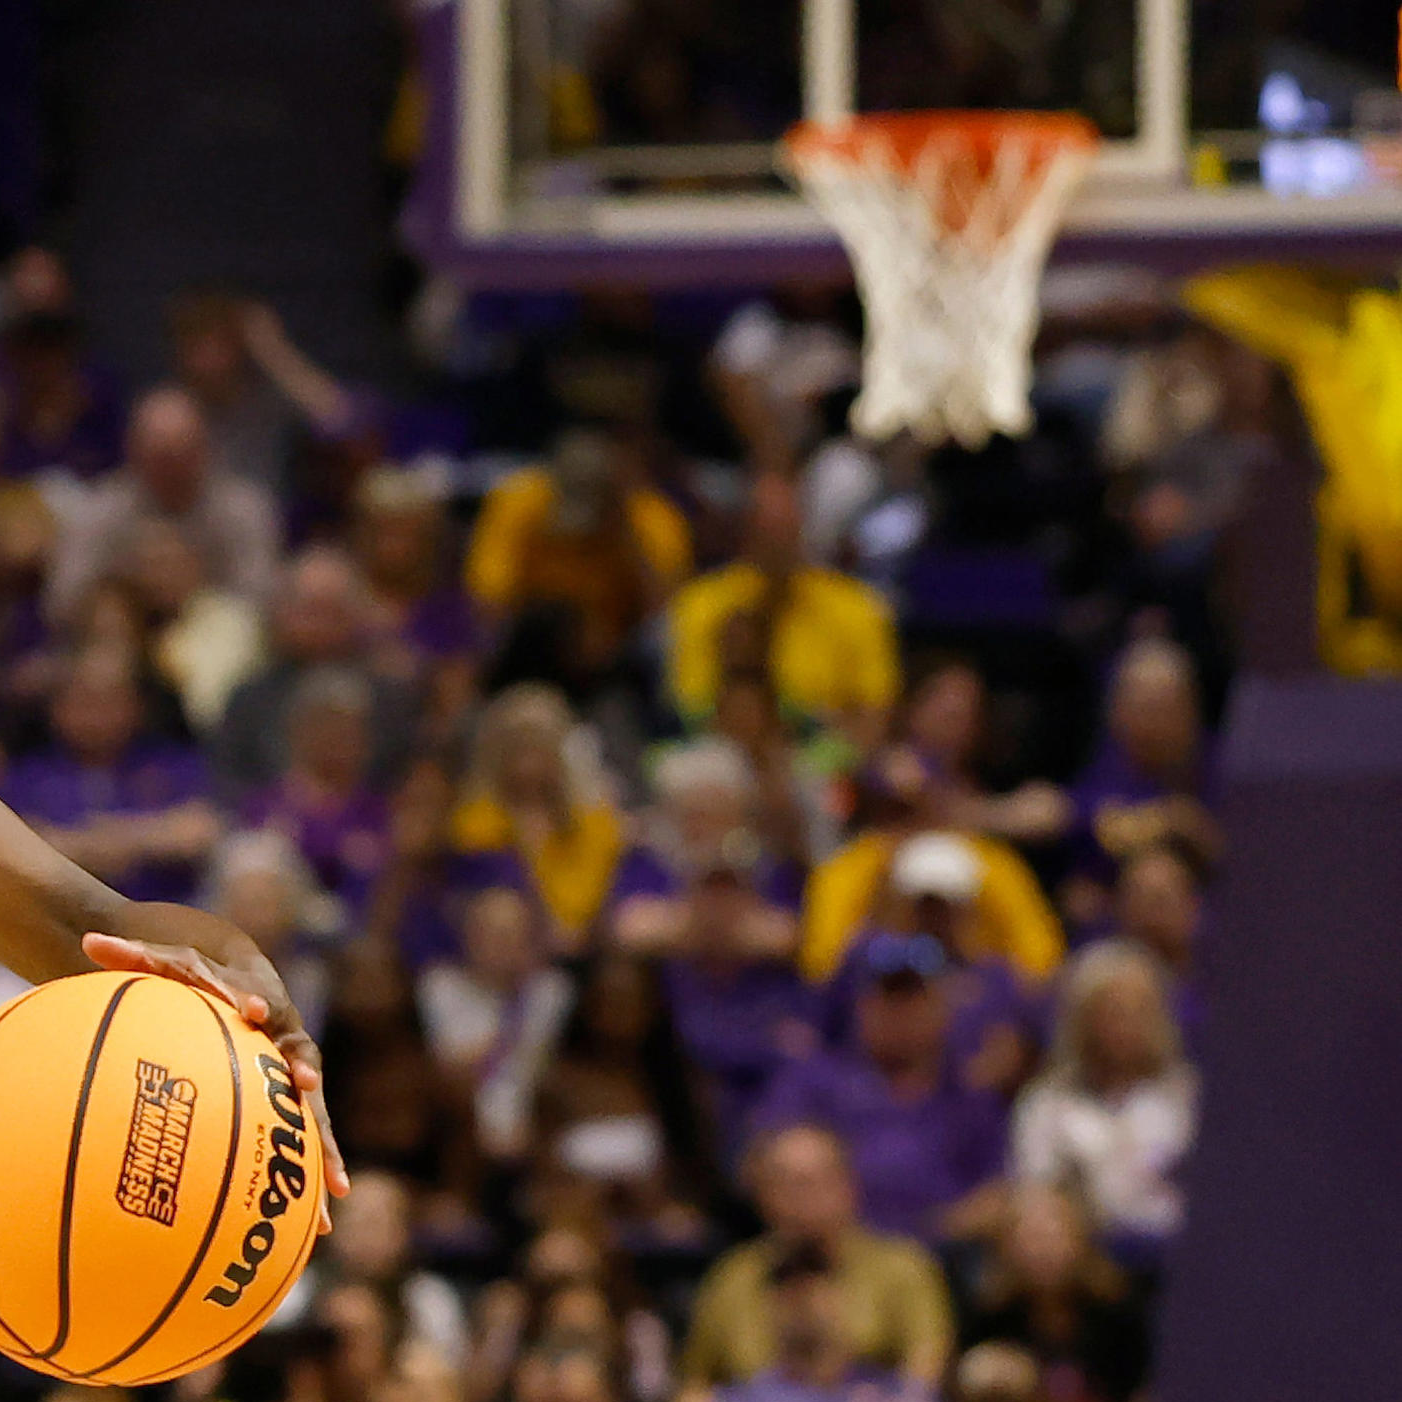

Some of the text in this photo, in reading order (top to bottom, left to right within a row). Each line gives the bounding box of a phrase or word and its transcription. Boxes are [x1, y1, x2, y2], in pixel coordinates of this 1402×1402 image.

[122, 1100, 167, 1216] MADNESS
[154, 1098, 192, 1186] MARCH
[243, 1122, 265, 1212] EVO NXT
